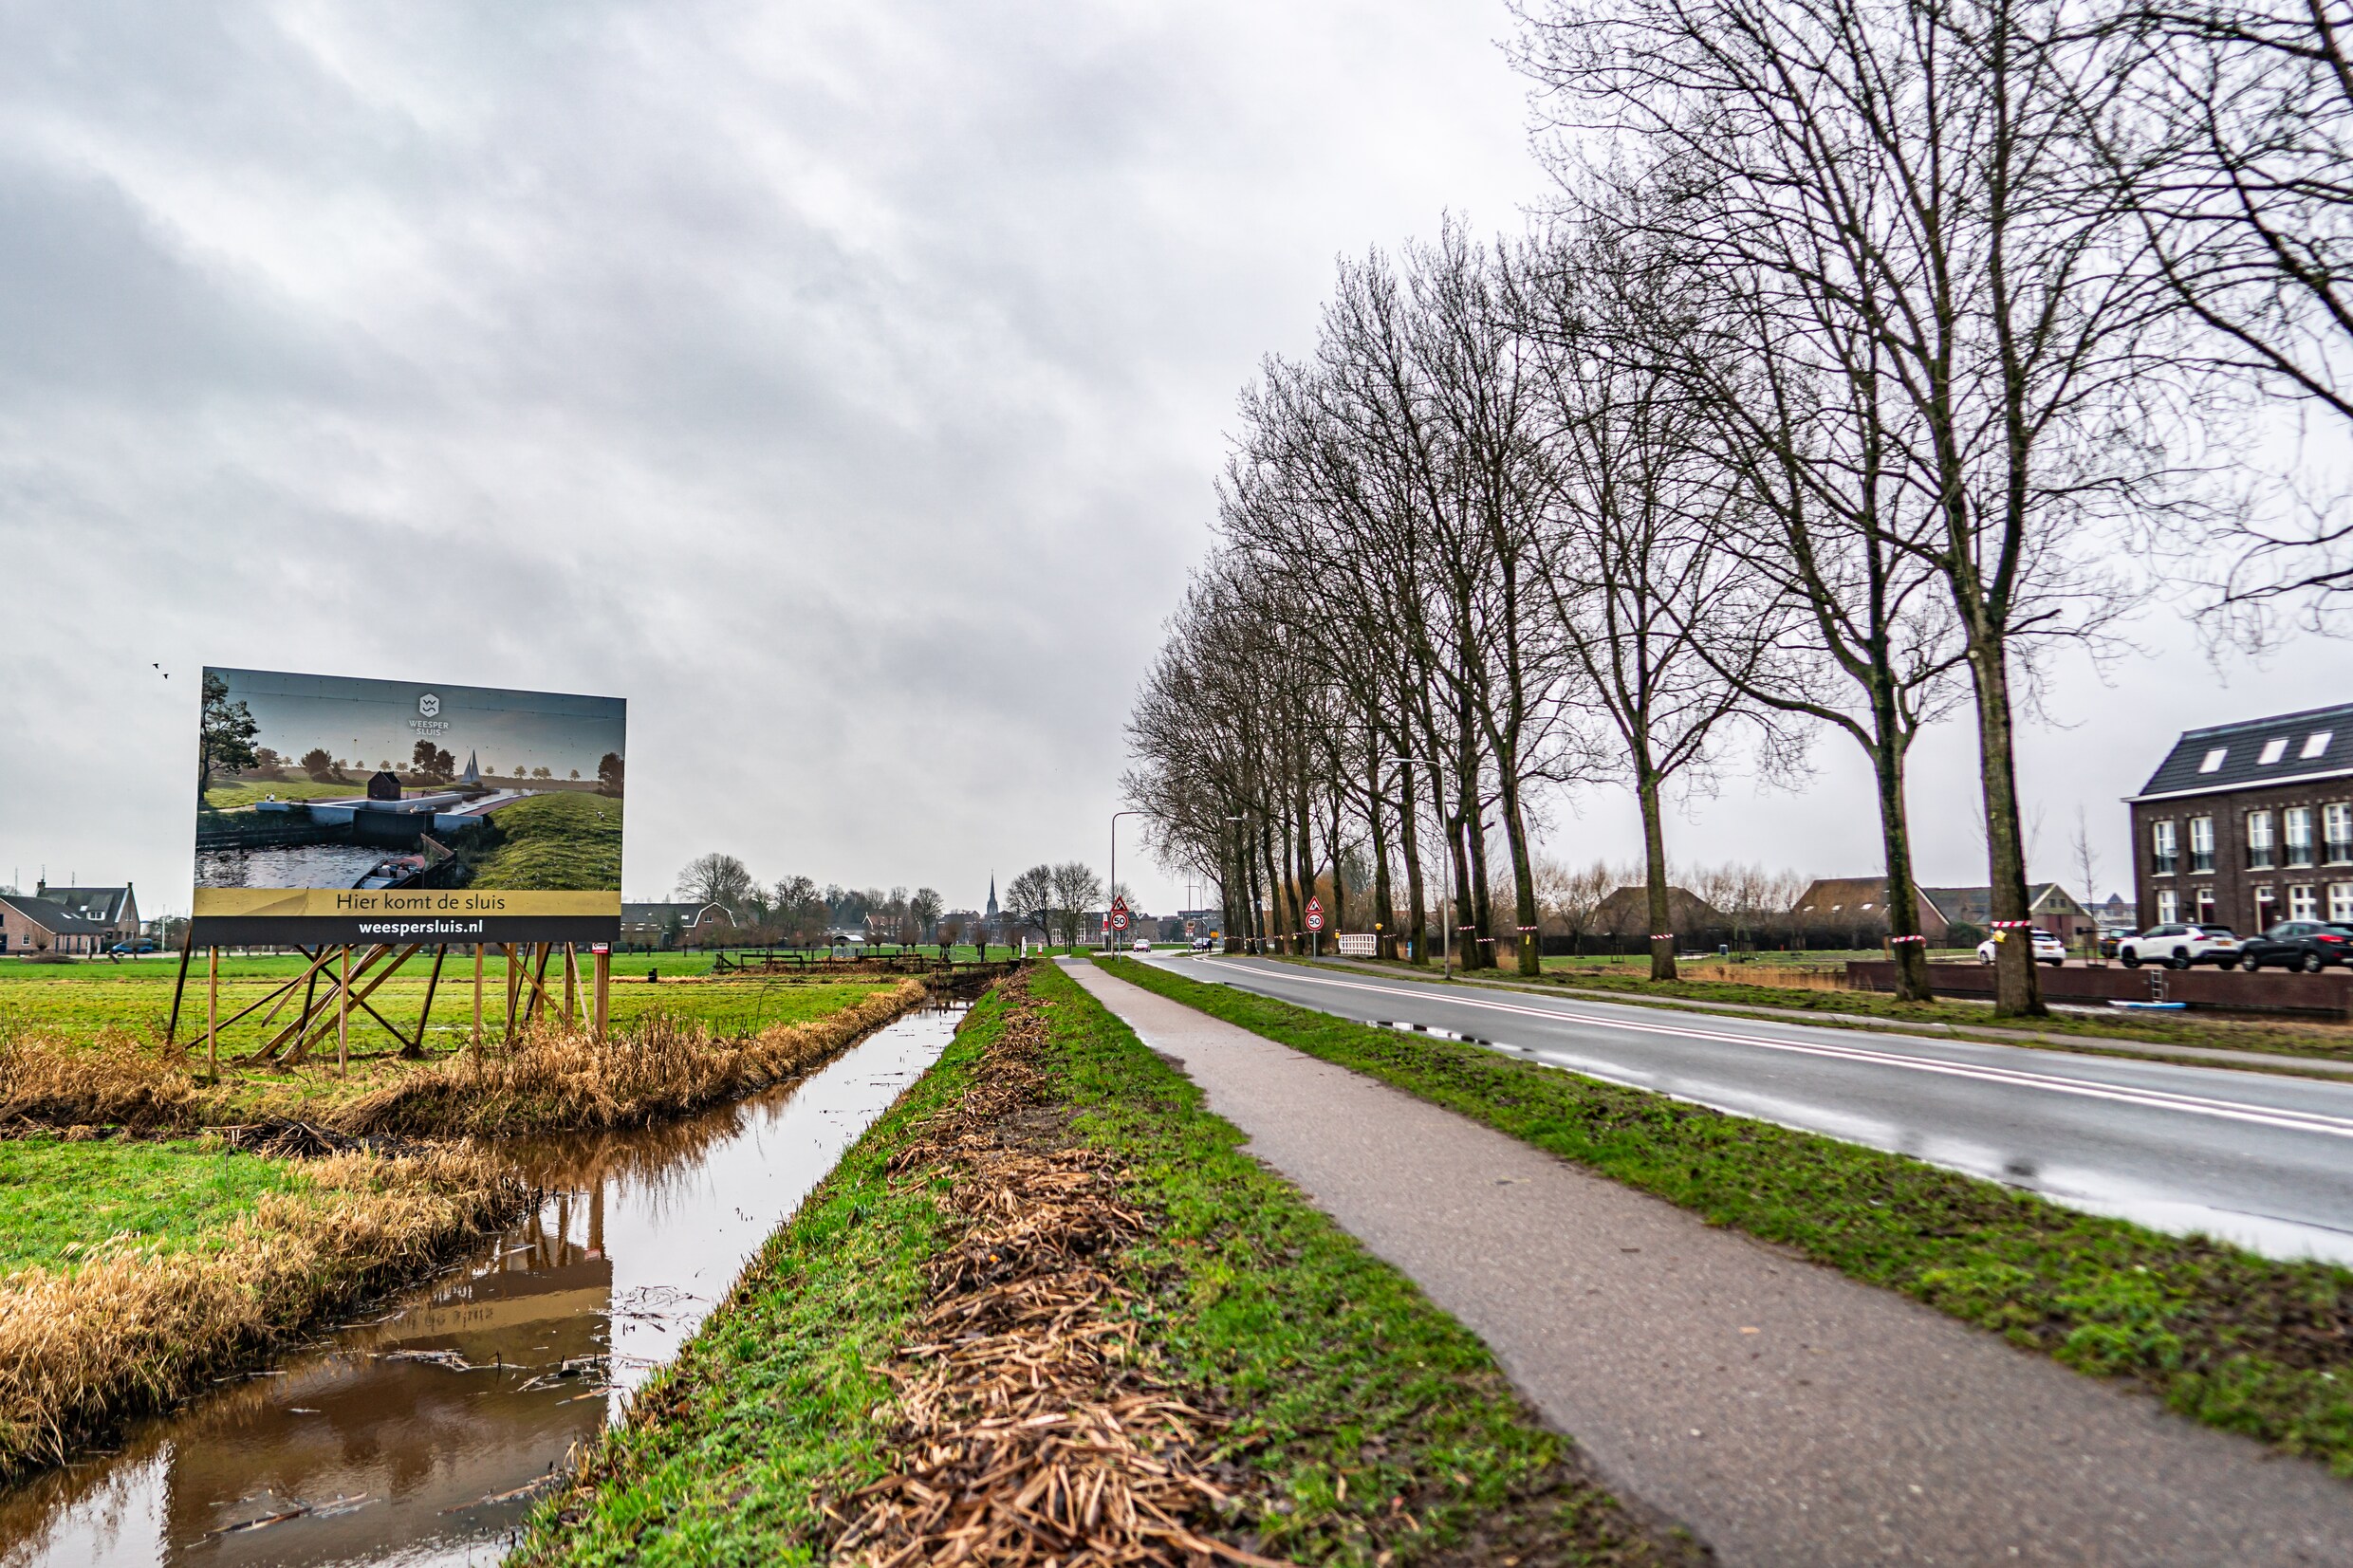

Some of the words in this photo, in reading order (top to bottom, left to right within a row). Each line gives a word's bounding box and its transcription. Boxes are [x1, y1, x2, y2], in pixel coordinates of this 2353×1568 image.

[409, 720, 449, 729] WEESPER
[337, 894, 378, 910] Hier
[384, 893, 432, 910] komt
[437, 894, 459, 910] de
[465, 894, 506, 910] sluis
[359, 919, 483, 936] weespersluis.nl
